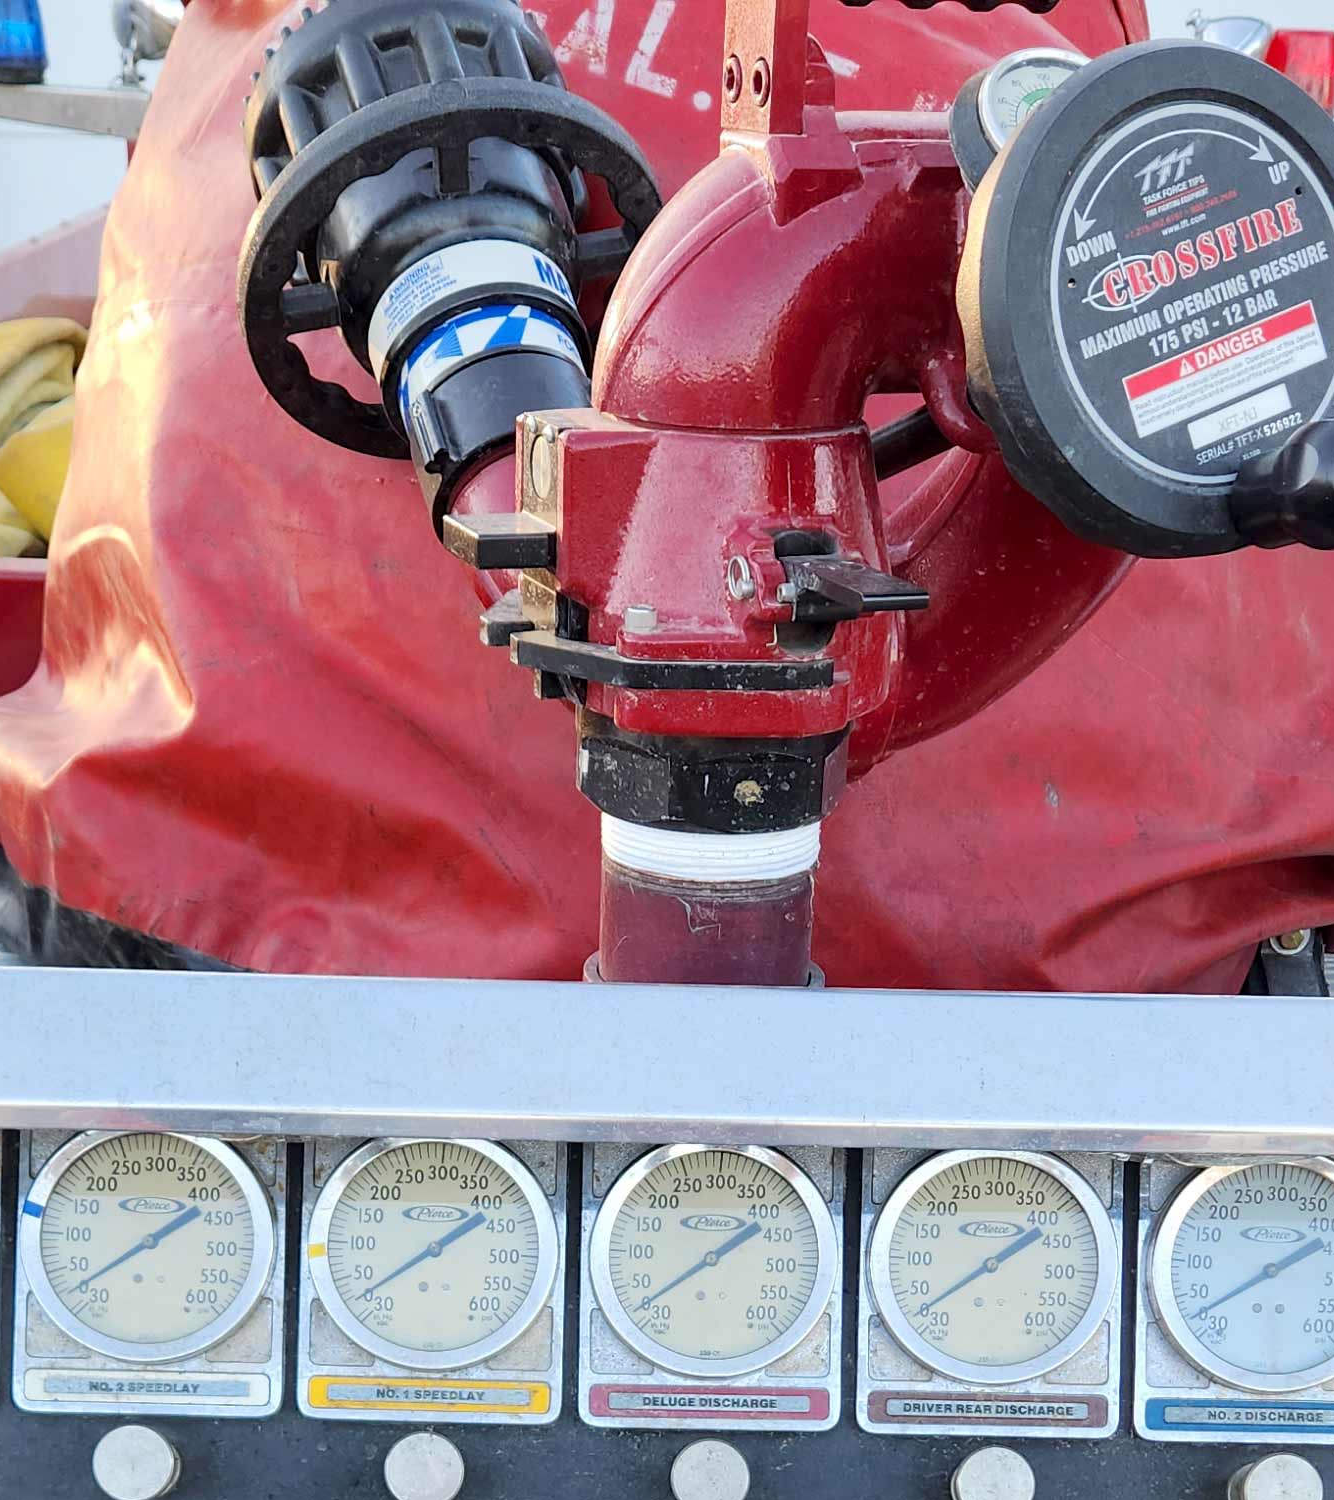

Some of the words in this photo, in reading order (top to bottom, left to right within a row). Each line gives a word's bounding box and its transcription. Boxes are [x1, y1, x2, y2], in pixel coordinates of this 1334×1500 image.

[1268, 161, 1290, 185] UP
[1143, 192, 1162, 206] TASK
[1165, 183, 1186, 199] FORCE
[1188, 175, 1204, 188] TIPS
[1066, 231, 1117, 267] DOWN
[1103, 198, 1303, 307] CROSSFIRE
[1079, 310, 1162, 360] MAXIMUM
[1163, 277, 1249, 324] OPERATING
[1252, 241, 1329, 288] PRESSURE
[1148, 334, 1180, 357] 175
[1182, 317, 1207, 342] PSI
[1223, 305, 1244, 326] 12
[1246, 289, 1279, 315] BAR
[1194, 327, 1266, 369] DANGER
[1196, 435, 1234, 466] SERIAL#
[1264, 413, 1303, 436] 526922
[89, 1381, 113, 1392] NO.
[117, 1382, 124, 1392] 2
[127, 1382, 200, 1393] SPEEDLAY
[376, 1388, 399, 1399] NO.
[403, 1389, 409, 1399] 1
[414, 1389, 485, 1401] SPEEDLAY
[642, 1396, 696, 1407] DELUGE
[698, 1397, 778, 1409] DISCHARGE
[903, 1403, 952, 1414] DRIVER
[955, 1404, 992, 1414] REAR
[995, 1405, 1074, 1416] DISCHARGE
[1207, 1410, 1231, 1421] NO.
[1234, 1411, 1242, 1421] 2
[1245, 1411, 1324, 1422] DISCHARGE
